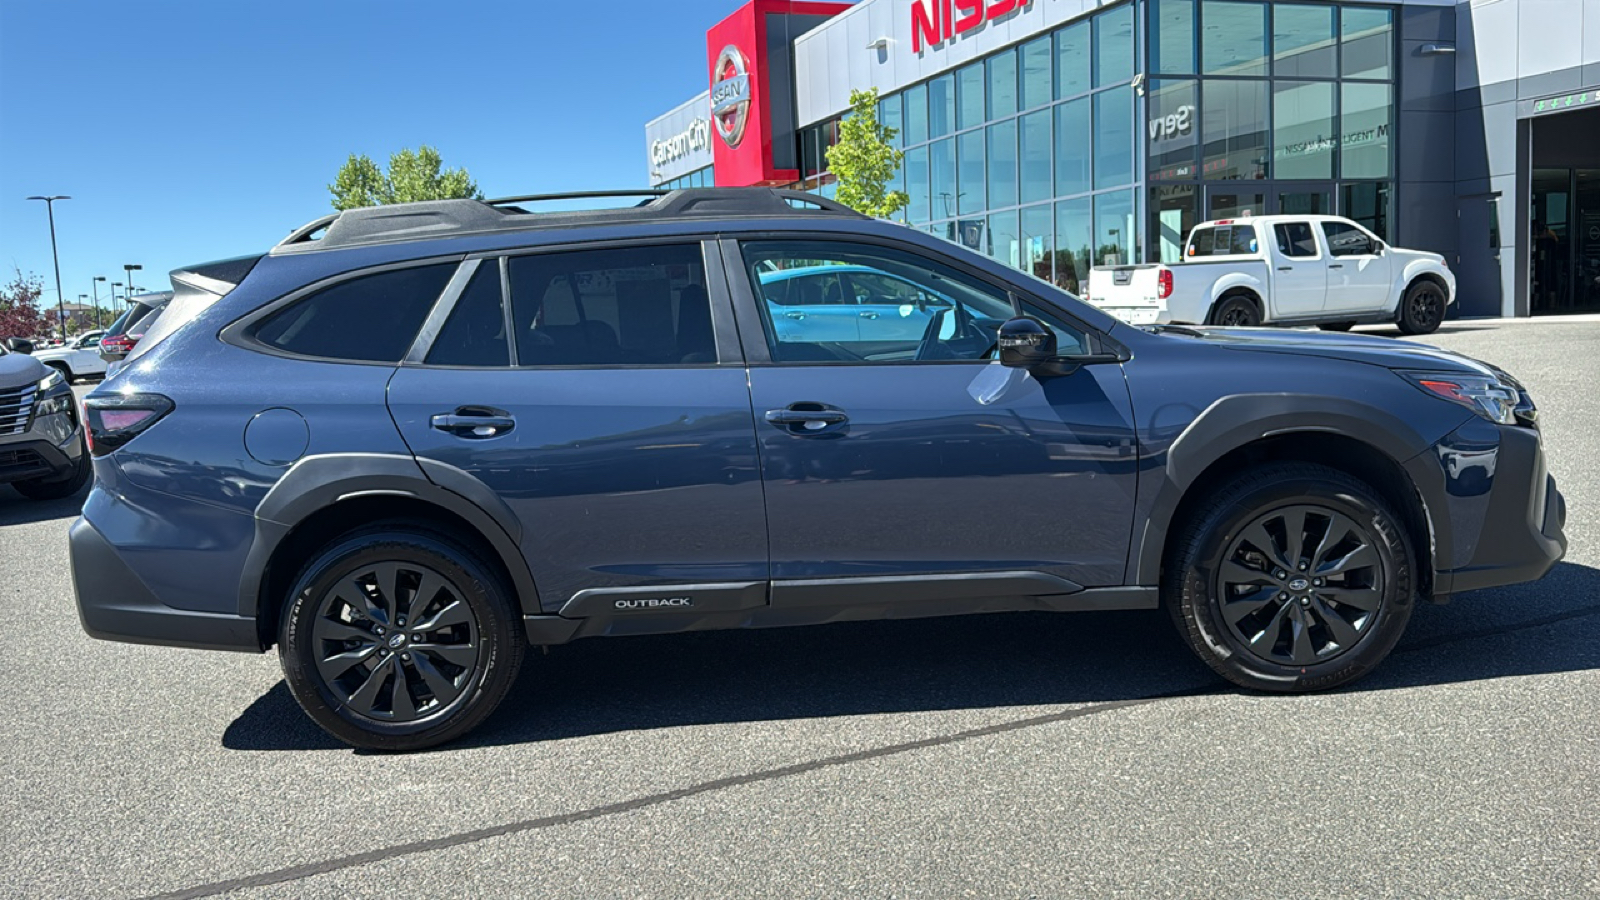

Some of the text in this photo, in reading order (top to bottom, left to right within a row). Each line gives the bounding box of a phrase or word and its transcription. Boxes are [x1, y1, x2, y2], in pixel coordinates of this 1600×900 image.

[651, 116, 711, 165] Carson City
[615, 598, 690, 608] OUTBACK
